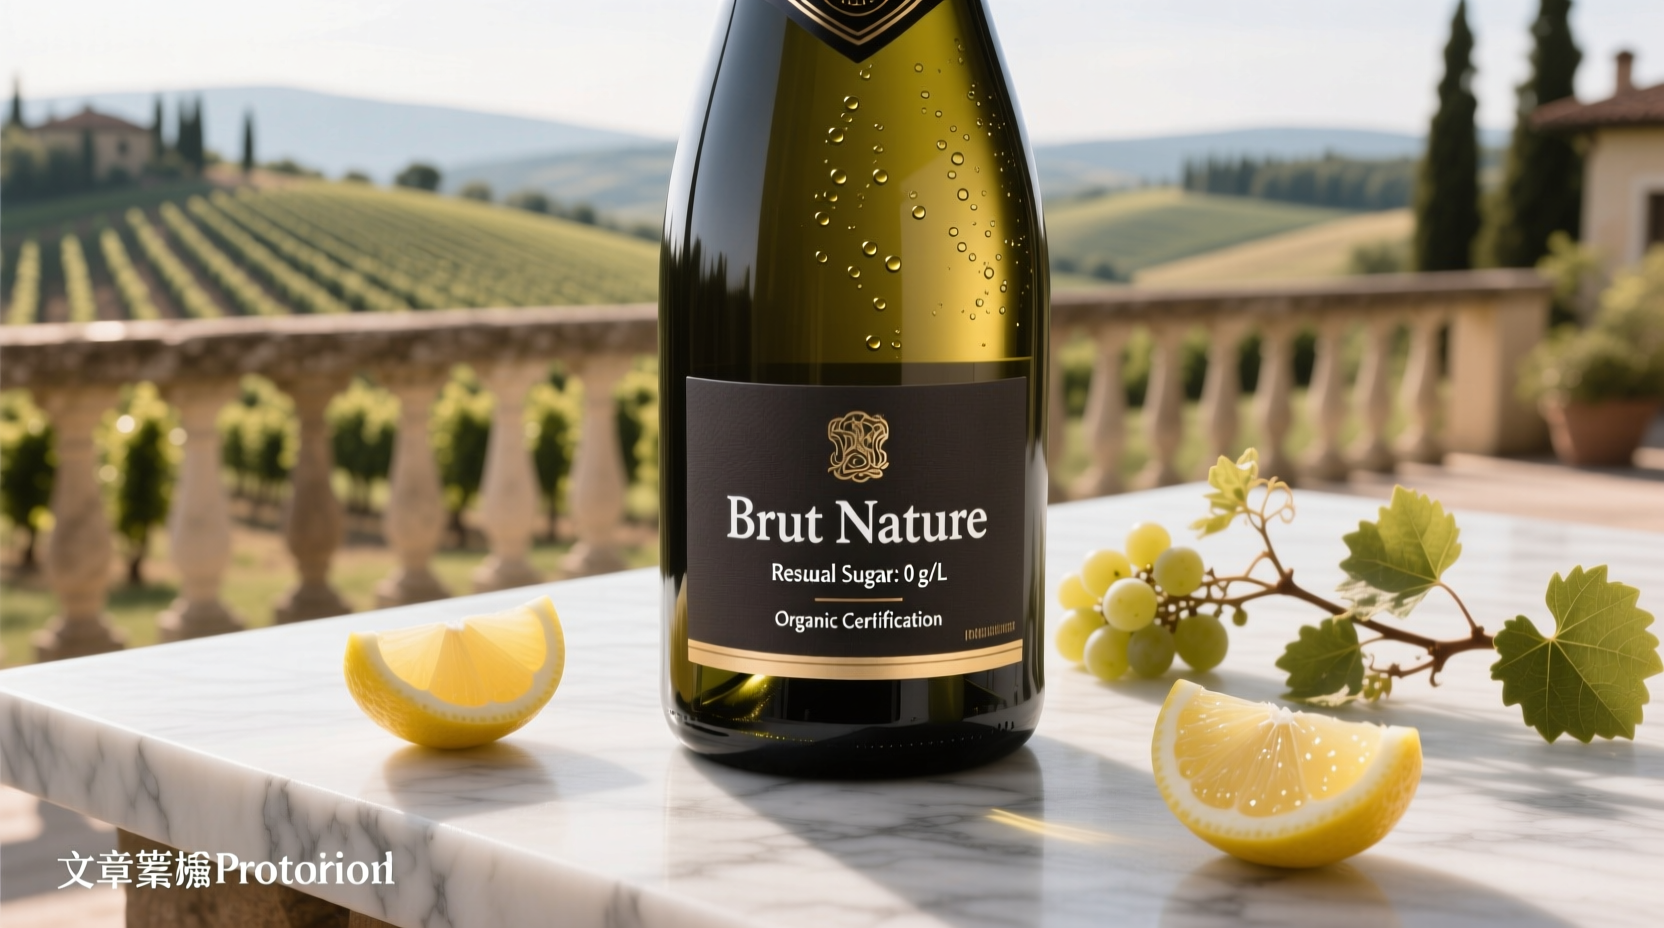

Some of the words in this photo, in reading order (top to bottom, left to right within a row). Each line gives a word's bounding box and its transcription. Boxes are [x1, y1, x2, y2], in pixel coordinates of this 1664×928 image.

[727, 495, 823, 544] Brut
[835, 500, 987, 544] Nature
[842, 565, 899, 589] Sugar:
[904, 564, 915, 582] 0
[918, 562, 948, 588] g/L
[775, 610, 838, 633] Organic
